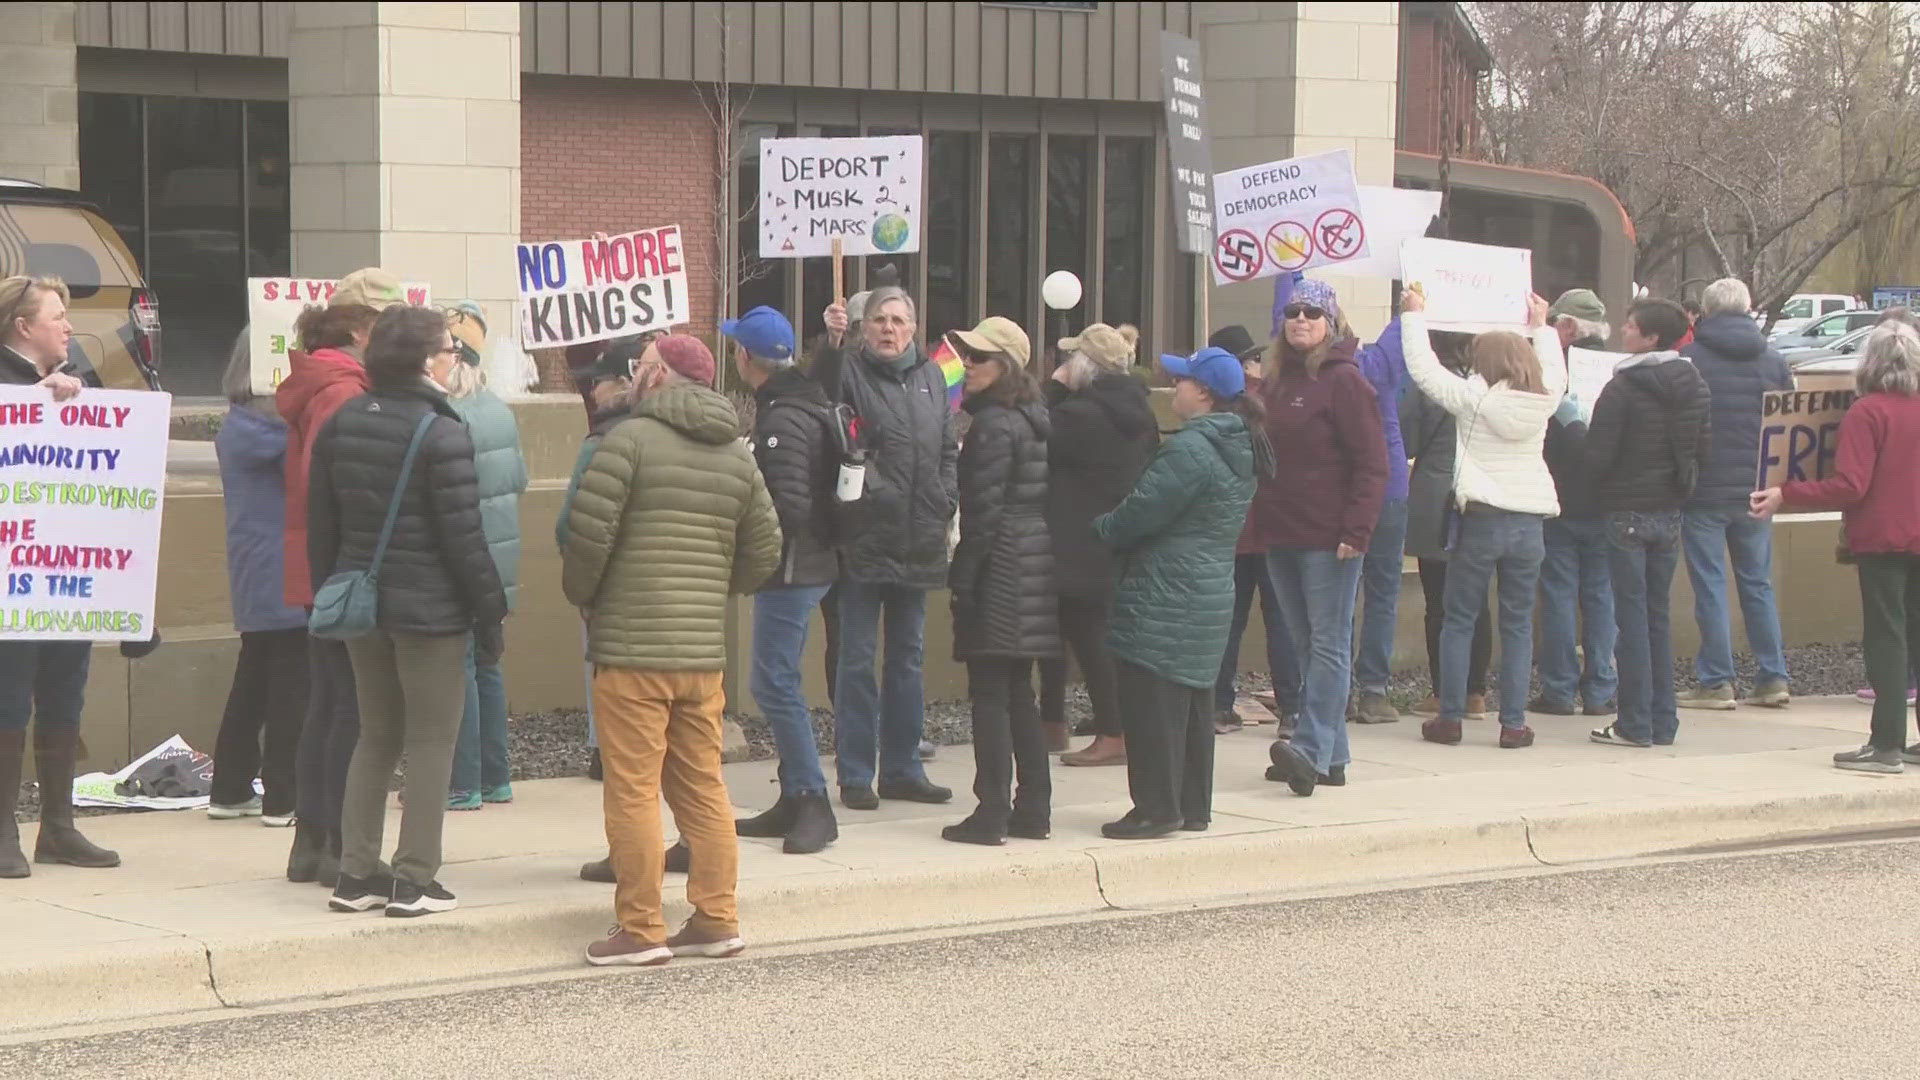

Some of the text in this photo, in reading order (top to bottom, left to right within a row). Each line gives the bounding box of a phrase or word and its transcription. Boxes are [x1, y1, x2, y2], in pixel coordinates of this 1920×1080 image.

[781, 155, 889, 183] DEPORT
[1241, 164, 1301, 190] DEFEND
[794, 185, 898, 211] MUSK 2
[1224, 184, 1318, 217] DEMOCRACY
[809, 217, 867, 237] MARS
[517, 227, 682, 292] NO MORE
[60, 405, 131, 428] ONLY
[10, 545, 133, 570] COUNTRY
[8, 573, 93, 598] IS THE
